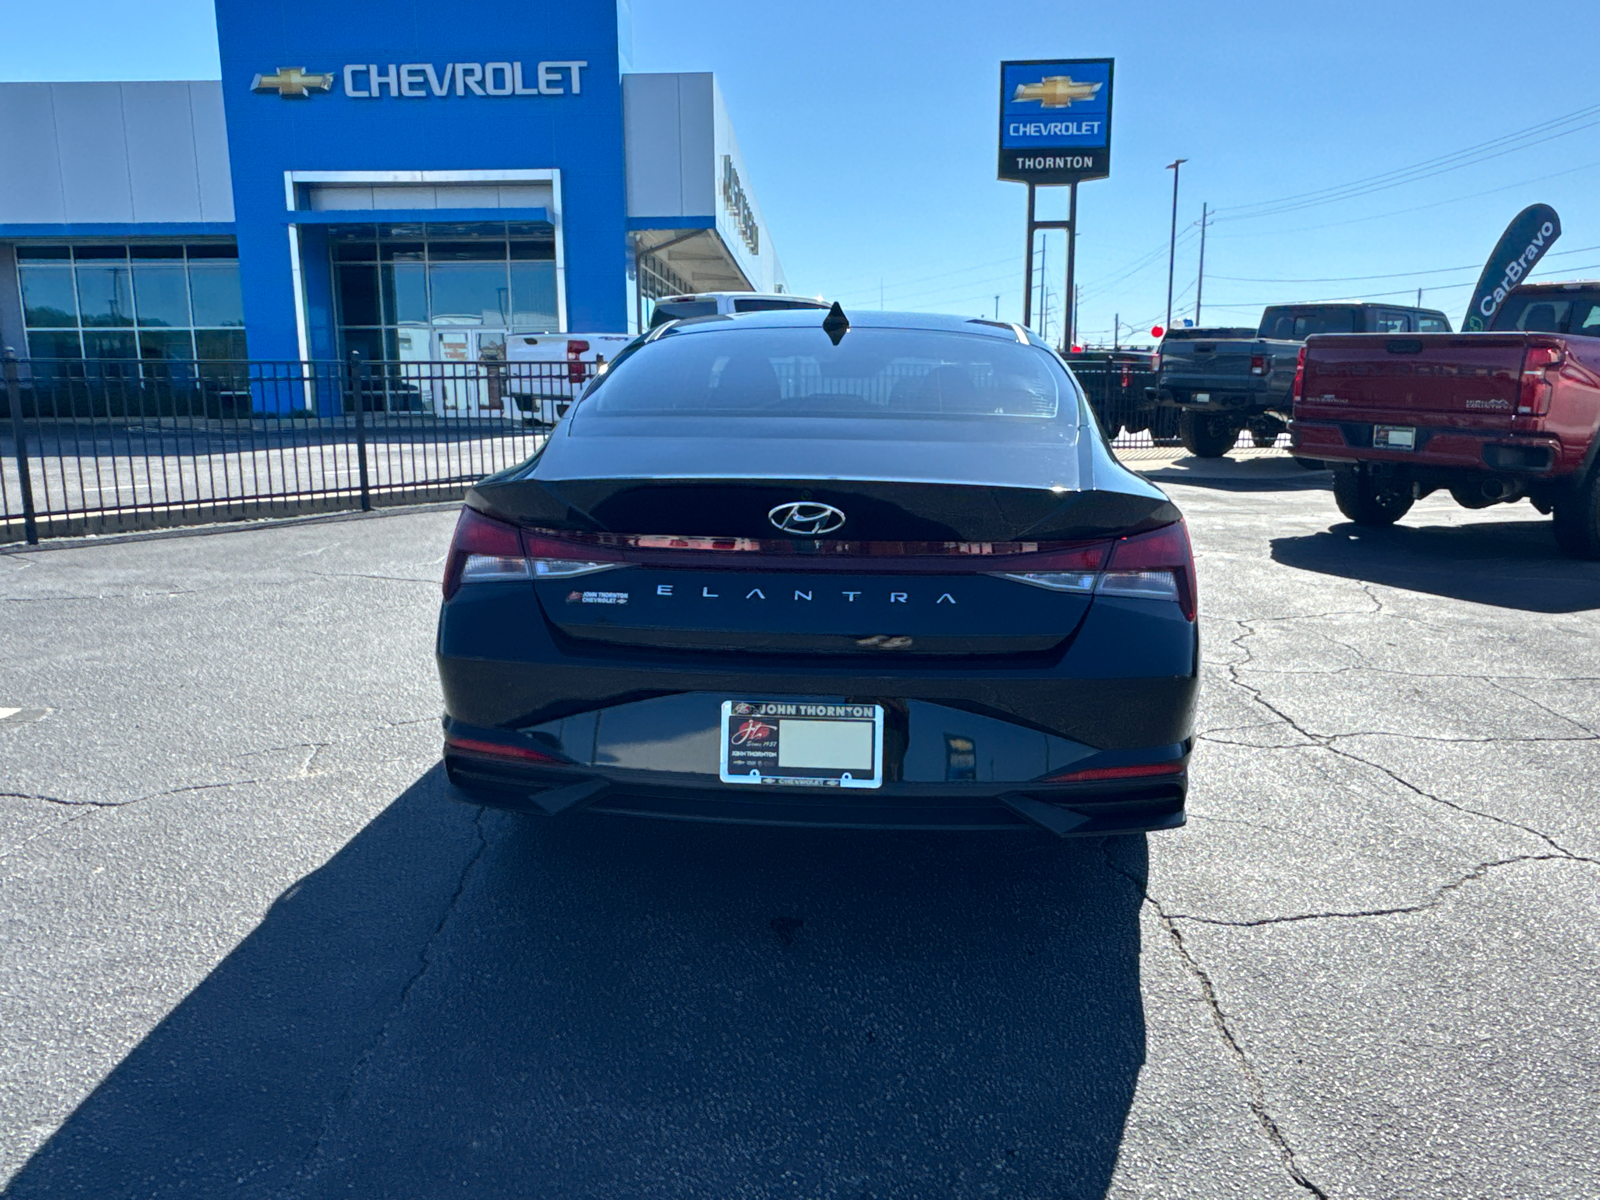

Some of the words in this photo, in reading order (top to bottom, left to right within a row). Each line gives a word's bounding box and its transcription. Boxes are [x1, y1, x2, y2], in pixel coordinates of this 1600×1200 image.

[343, 60, 588, 98] CHEVROLET
[1009, 121, 1101, 137] CHEVROLET
[1016, 156, 1093, 170] THORNTON
[1480, 221, 1554, 317] CarBravo
[656, 584, 957, 604] ELANTRA
[760, 704, 797, 716] JOHN
[800, 705, 874, 718] THORNTON
[747, 750, 778, 758] THORNTON
